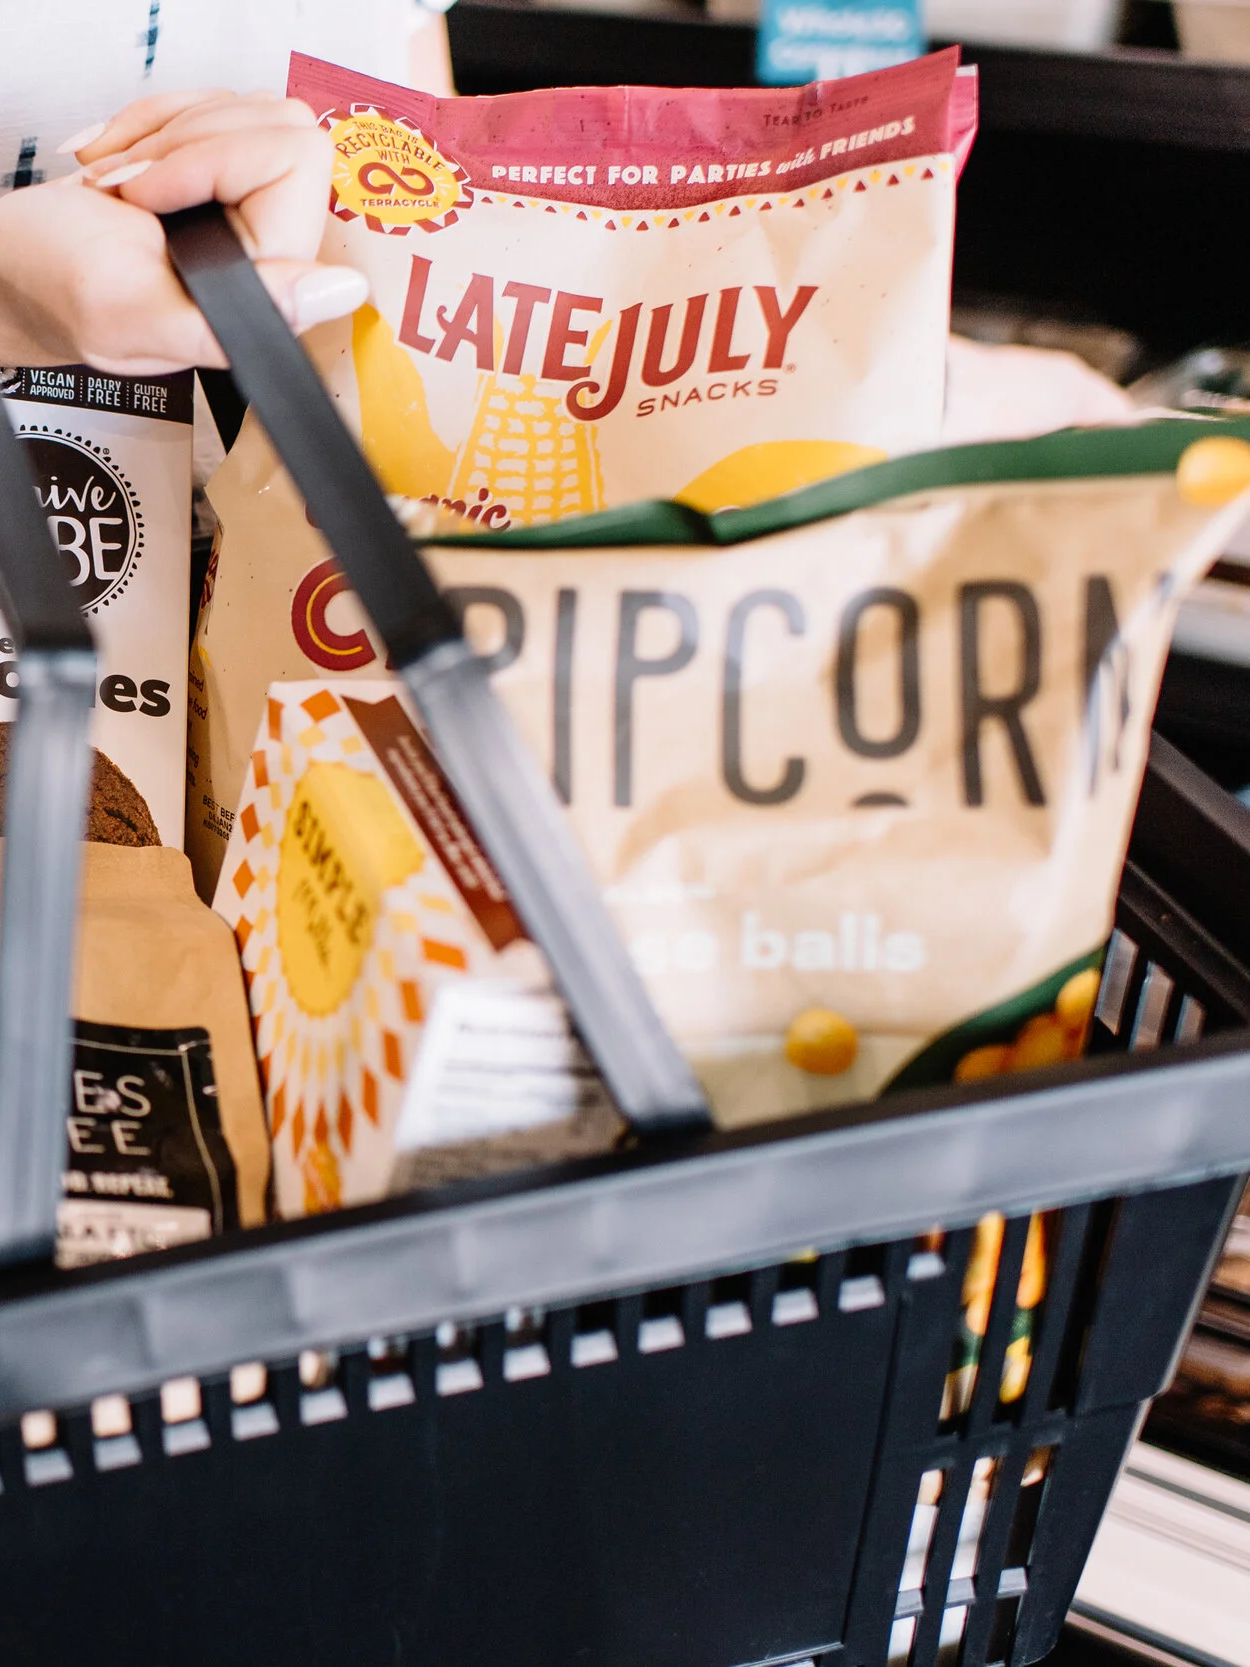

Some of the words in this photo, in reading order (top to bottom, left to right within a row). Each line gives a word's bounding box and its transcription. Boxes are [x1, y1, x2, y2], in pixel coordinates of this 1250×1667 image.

[335, 132, 446, 173] RECYCLABLE
[375, 150, 411, 165] WITH
[492, 164, 597, 185] PERFECT
[608, 165, 659, 185] FOR
[670, 161, 772, 185] PARTIES
[775, 147, 816, 176] with
[818, 115, 917, 162] FRIENDS
[359, 198, 440, 208] TERRACYCLE
[398, 253, 604, 382] LATE
[565, 285, 819, 422] JULY
[29, 369, 75, 388] VEGAN
[87, 376, 122, 392] DAIRY
[29, 385, 75, 400] APPROVED
[87, 388, 121, 407] FREE
[134, 383, 168, 398] GLUTEN
[636, 379, 778, 417] SNACKS
[133, 395, 167, 414] FREE
[220, 805, 236, 821] BEF
[739, 909, 928, 974] balls
